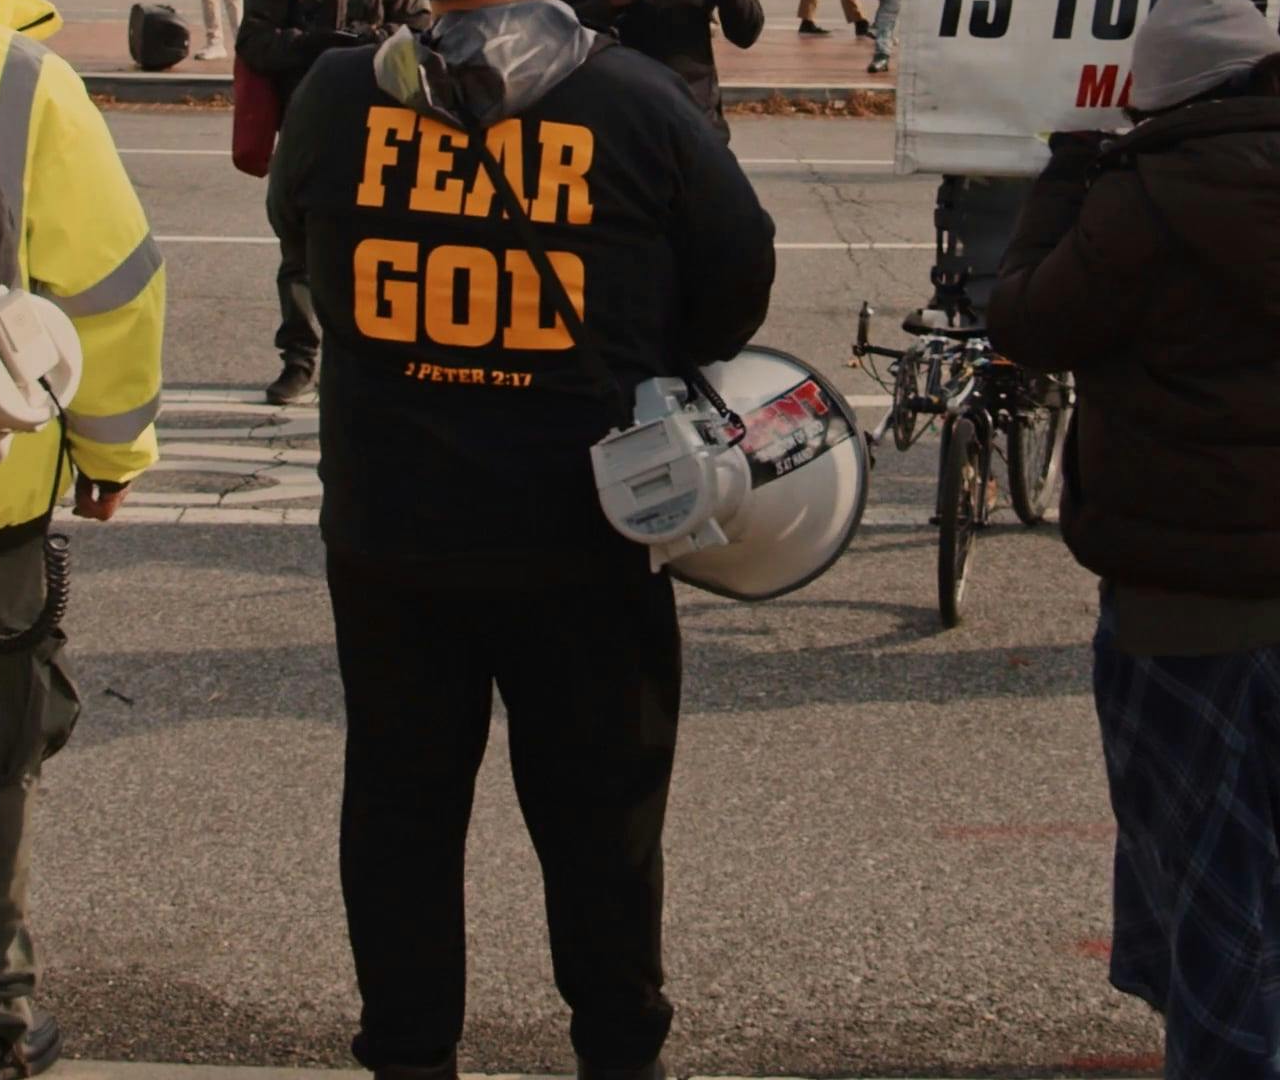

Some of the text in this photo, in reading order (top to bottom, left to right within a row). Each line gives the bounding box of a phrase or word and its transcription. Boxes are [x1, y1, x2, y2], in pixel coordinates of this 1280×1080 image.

[356, 106, 594, 224] FEAR
[353, 238, 585, 350] GOD
[417, 362, 486, 385] PETER
[491, 370, 533, 387] 2:17
